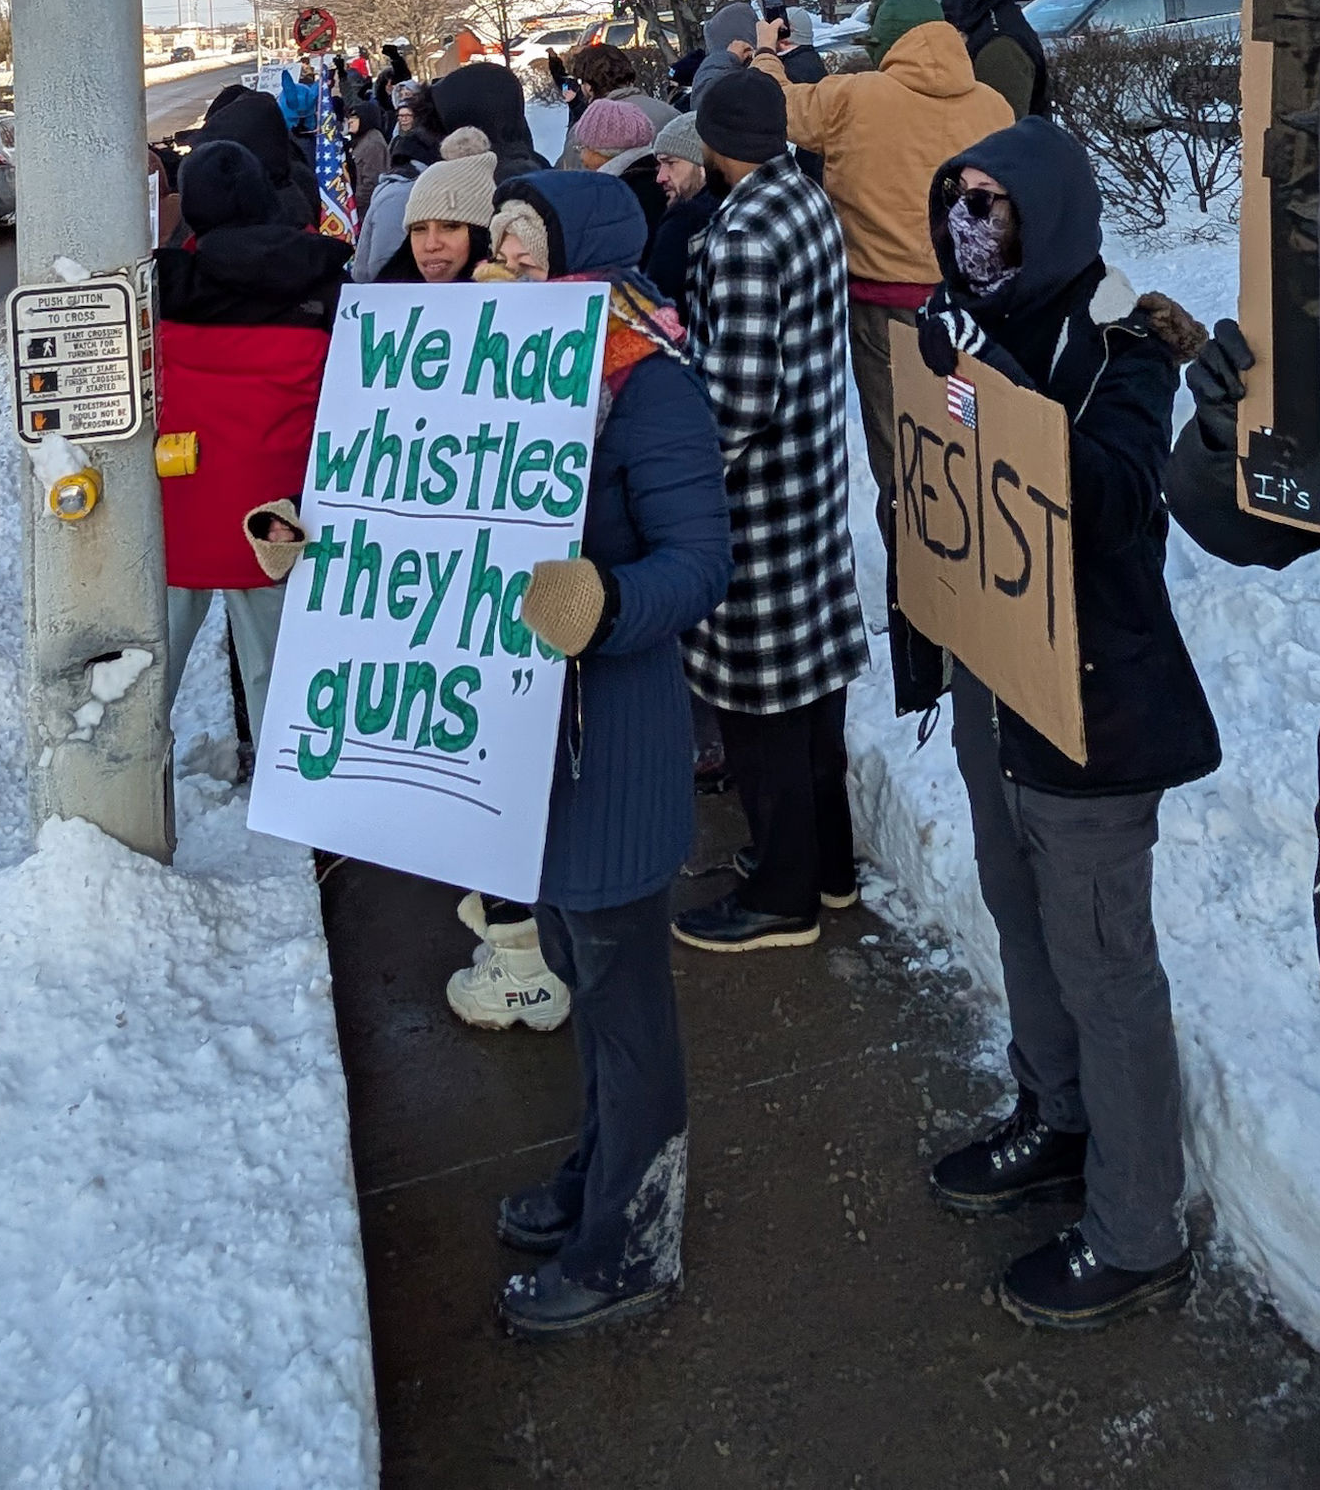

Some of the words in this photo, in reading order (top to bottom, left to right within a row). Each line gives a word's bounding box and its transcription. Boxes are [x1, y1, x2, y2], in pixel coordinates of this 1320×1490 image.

[38, 297, 63, 308] PUSH
[66, 293, 103, 306] BUTTON
[48, 314, 60, 324] TO
[65, 311, 96, 323] CROSS
[63, 331, 84, 340] START
[87, 328, 123, 338] CROSSING
[73, 341, 97, 350] WATCH
[100, 340, 114, 348] FOR
[462, 294, 605, 408] had
[67, 349, 98, 358] TURNING
[102, 347, 121, 356] CARS
[72, 366, 92, 376] DON'T
[96, 364, 117, 373] START
[64, 378, 88, 387] FINISH
[91, 374, 126, 384] CROSSING
[86, 383, 116, 393] STARTED
[73, 399, 121, 411] PEDESTRIANS
[69, 412, 97, 421] SHOULD
[101, 410, 115, 418] NOT
[118, 408, 127, 416] BE
[82, 418, 124, 429] CROSSWALK
[315, 408, 587, 519] whistles
[1253, 473, 1310, 510] It's
[898, 412, 1069, 650] RESIST
[303, 518, 462, 650] they
[458, 527, 580, 664] ha
[505, 987, 551, 1007] FILA
